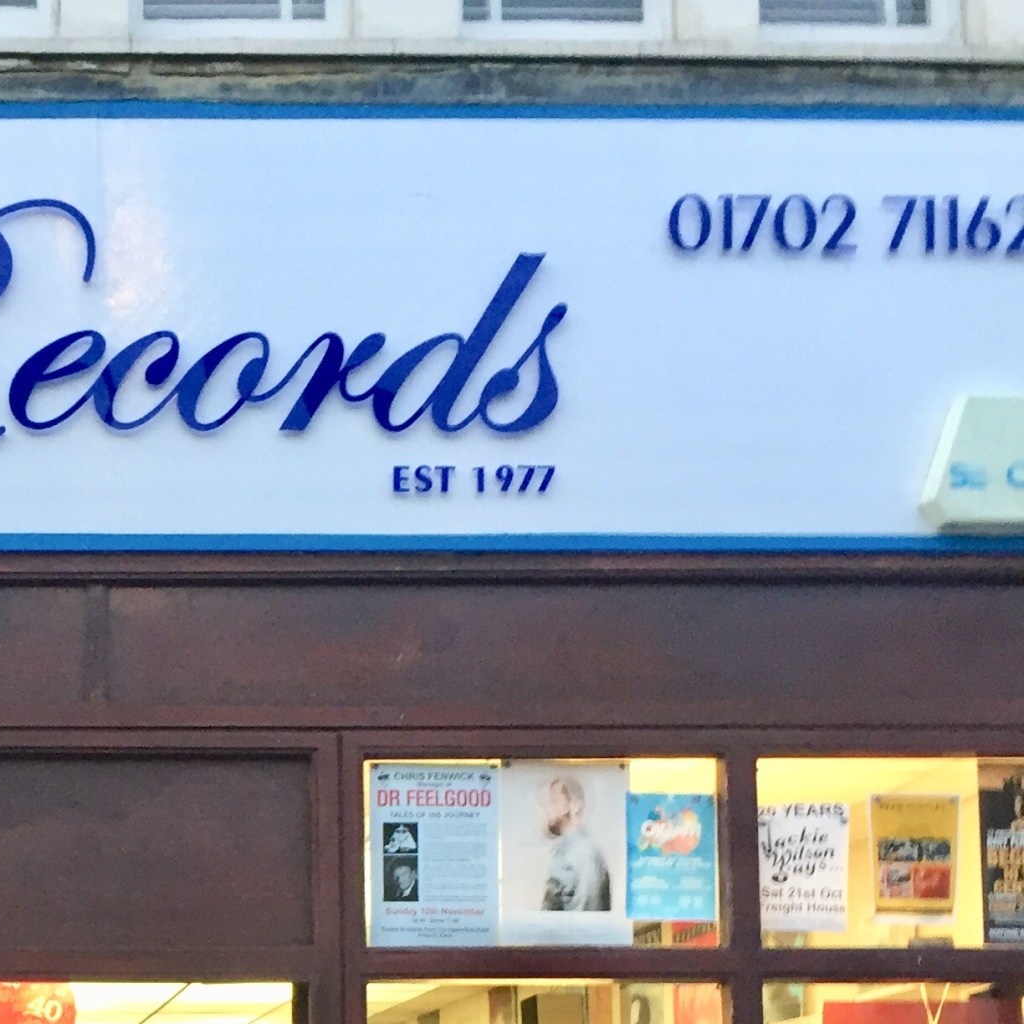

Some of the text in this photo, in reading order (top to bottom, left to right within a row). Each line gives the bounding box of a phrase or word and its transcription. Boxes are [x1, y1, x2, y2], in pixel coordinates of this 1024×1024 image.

[668, 193, 857, 255] 01702
[392, 466, 556, 494] EST 1977
[393, 771, 475, 781] CHRIS FENWICK
[377, 789, 492, 808] DR FEELGOOD
[784, 803, 845, 817] YEARS
[22, 996, 64, 1022] 40
